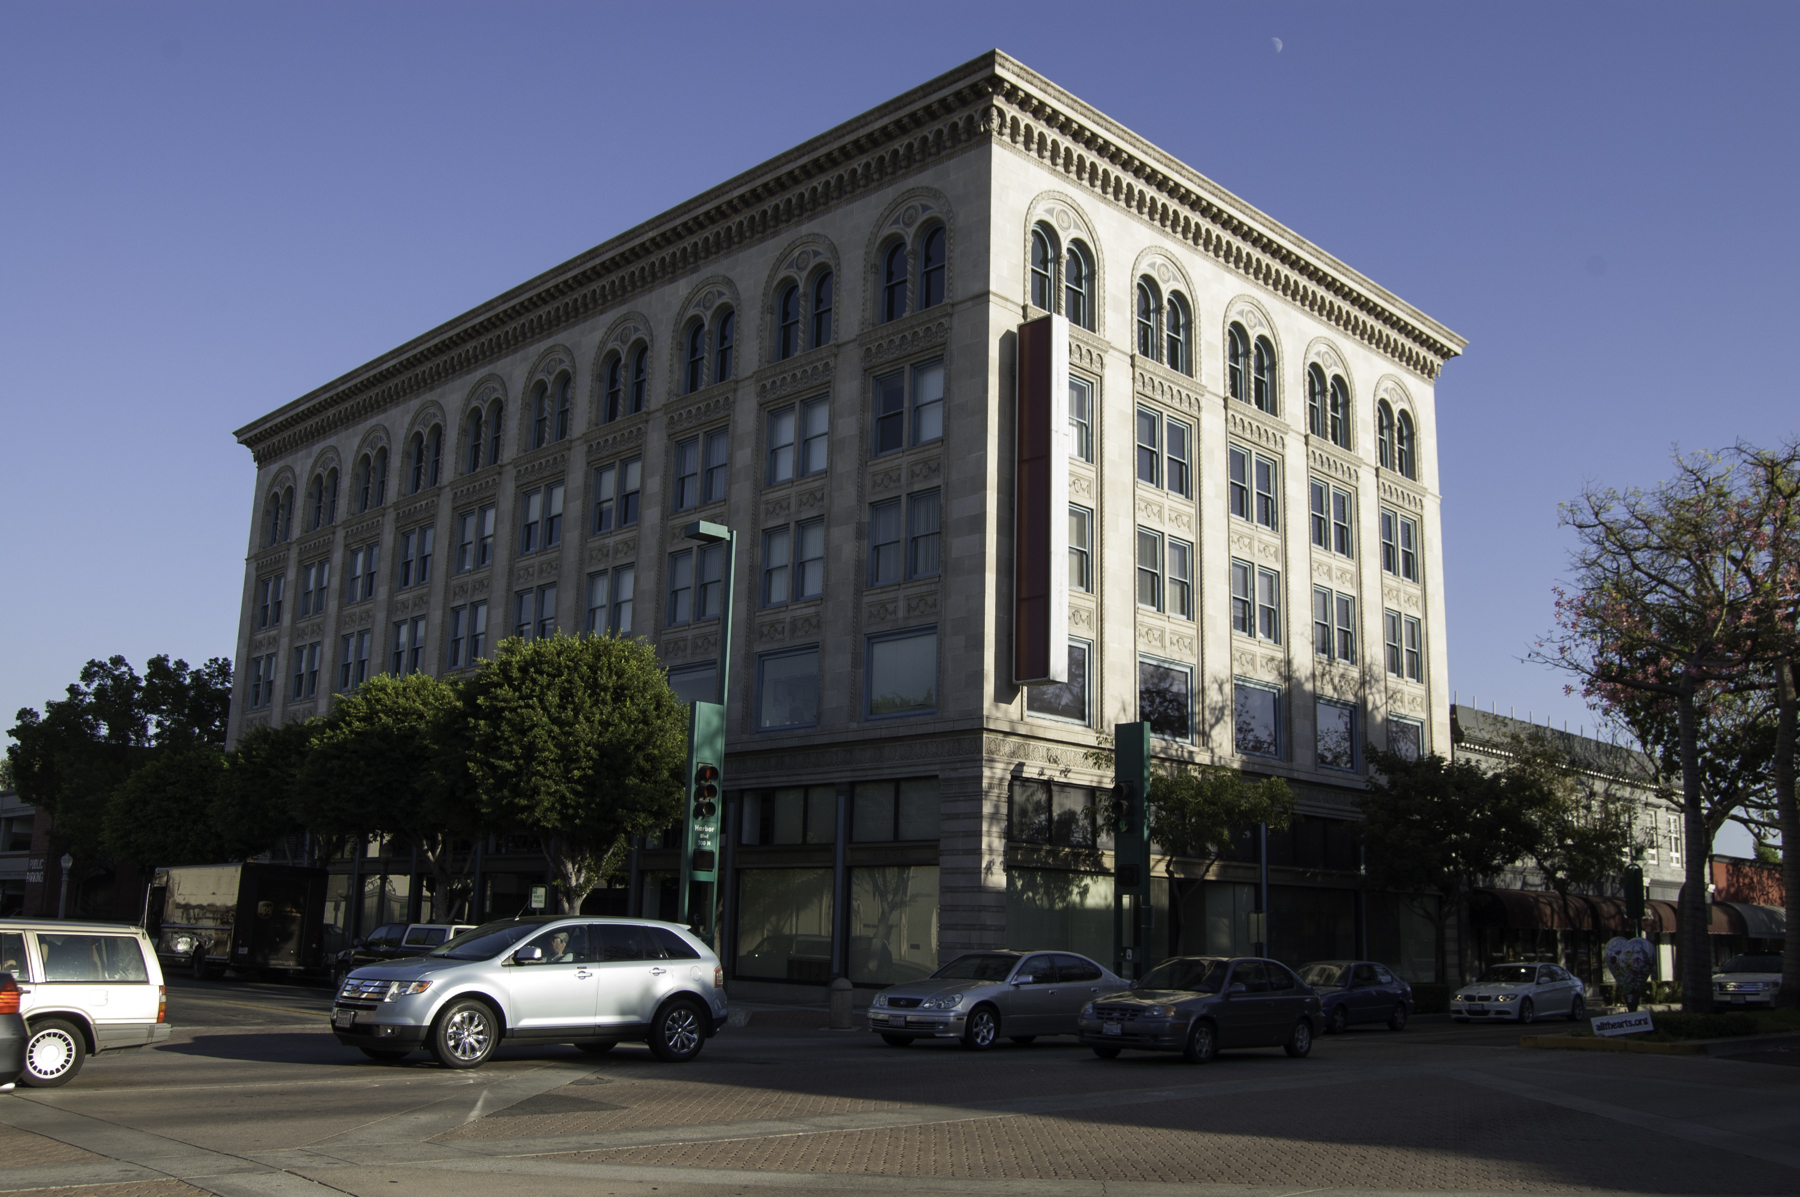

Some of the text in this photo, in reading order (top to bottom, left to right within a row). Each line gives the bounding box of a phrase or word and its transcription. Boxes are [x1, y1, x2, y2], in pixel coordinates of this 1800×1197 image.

[694, 824, 715, 833] Harbor
[29, 858, 44, 870] PUBLIC
[26, 871, 44, 883] PARKING
[1595, 1017, 1649, 1031] allthearts.org
